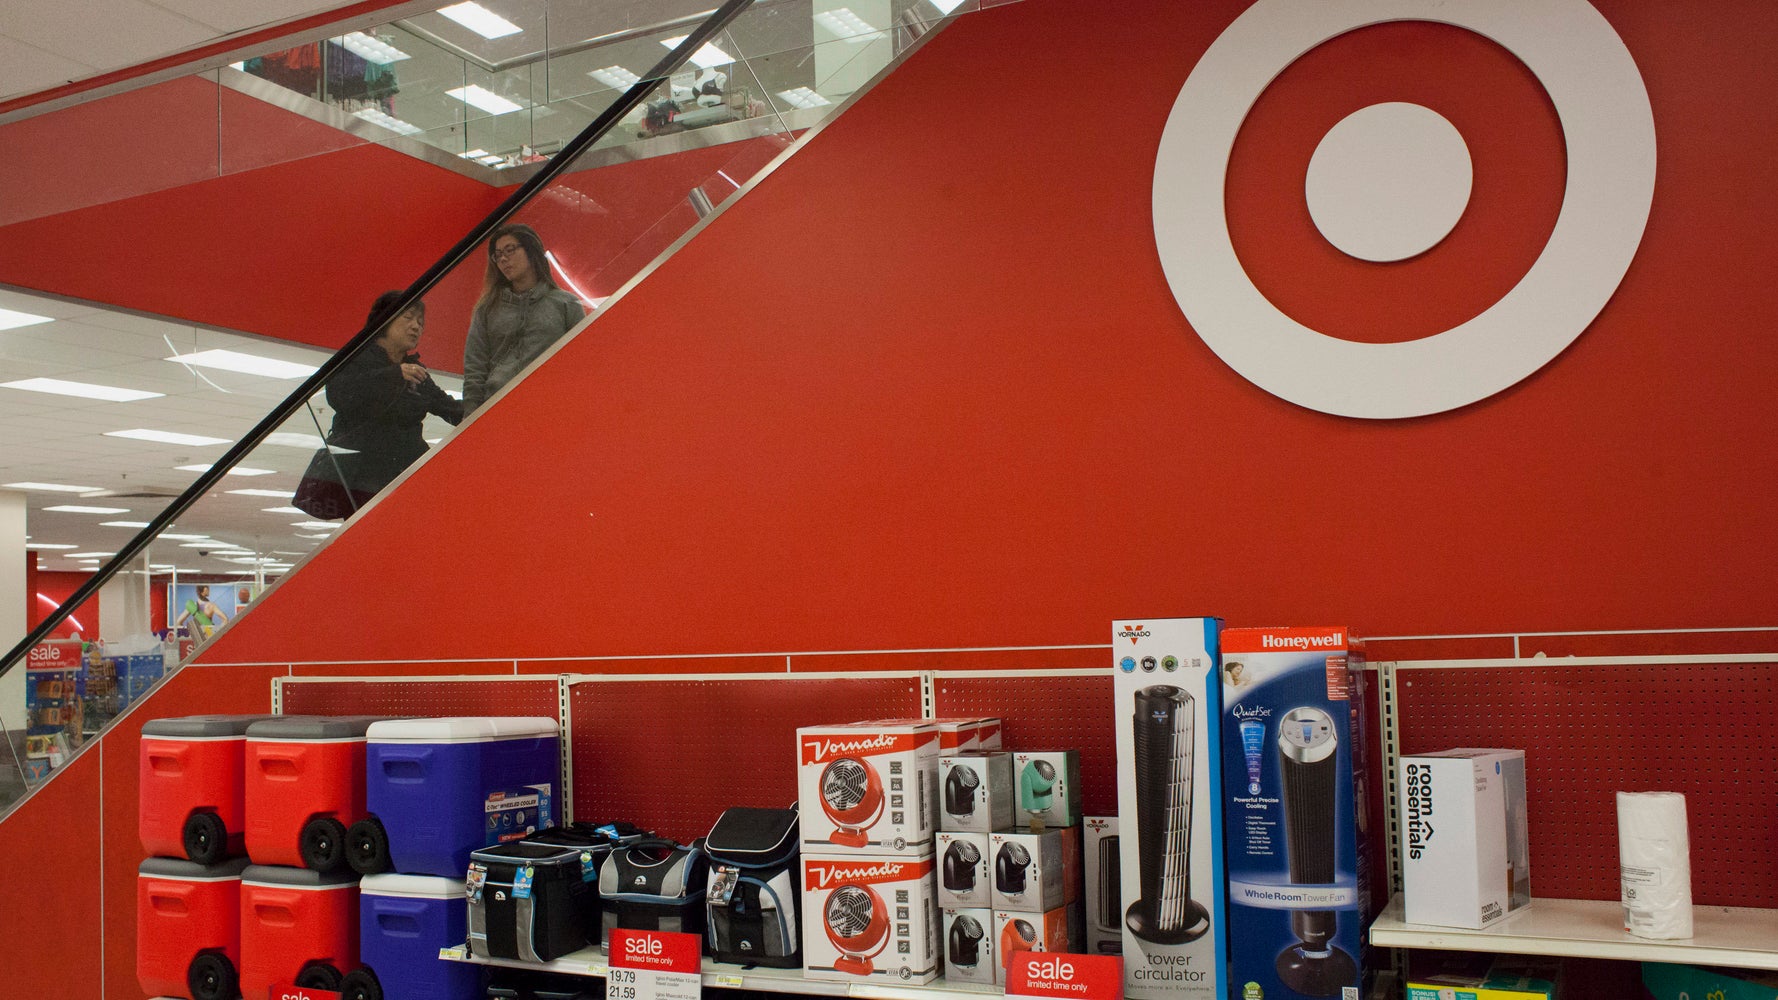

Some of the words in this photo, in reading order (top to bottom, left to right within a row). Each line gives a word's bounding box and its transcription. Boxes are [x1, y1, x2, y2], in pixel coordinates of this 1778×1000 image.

[1262, 633, 1342, 650] Honeywell
[30, 644, 60, 660] sale
[804, 734, 898, 761] Vornado
[1419, 764, 1432, 815] room
[1406, 763, 1426, 860] essentials
[809, 862, 904, 887] Vornado
[1245, 889, 1273, 900] Whole
[1274, 892, 1302, 901] Room
[1302, 893, 1328, 902] Tower
[1329, 893, 1345, 901] Fan
[625, 934, 663, 955] sale
[625, 954, 645, 963] limited
[646, 956, 660, 964] time
[660, 957, 674, 966] only
[1146, 952, 1192, 966] tower
[1027, 956, 1074, 980] sale
[1134, 966, 1206, 981] circulator
[609, 970, 636, 983] 19.79
[609, 985, 636, 999] 21.59
[1027, 979, 1052, 989] limited
[1053, 981, 1070, 990] time
[1071, 983, 1088, 993] only
